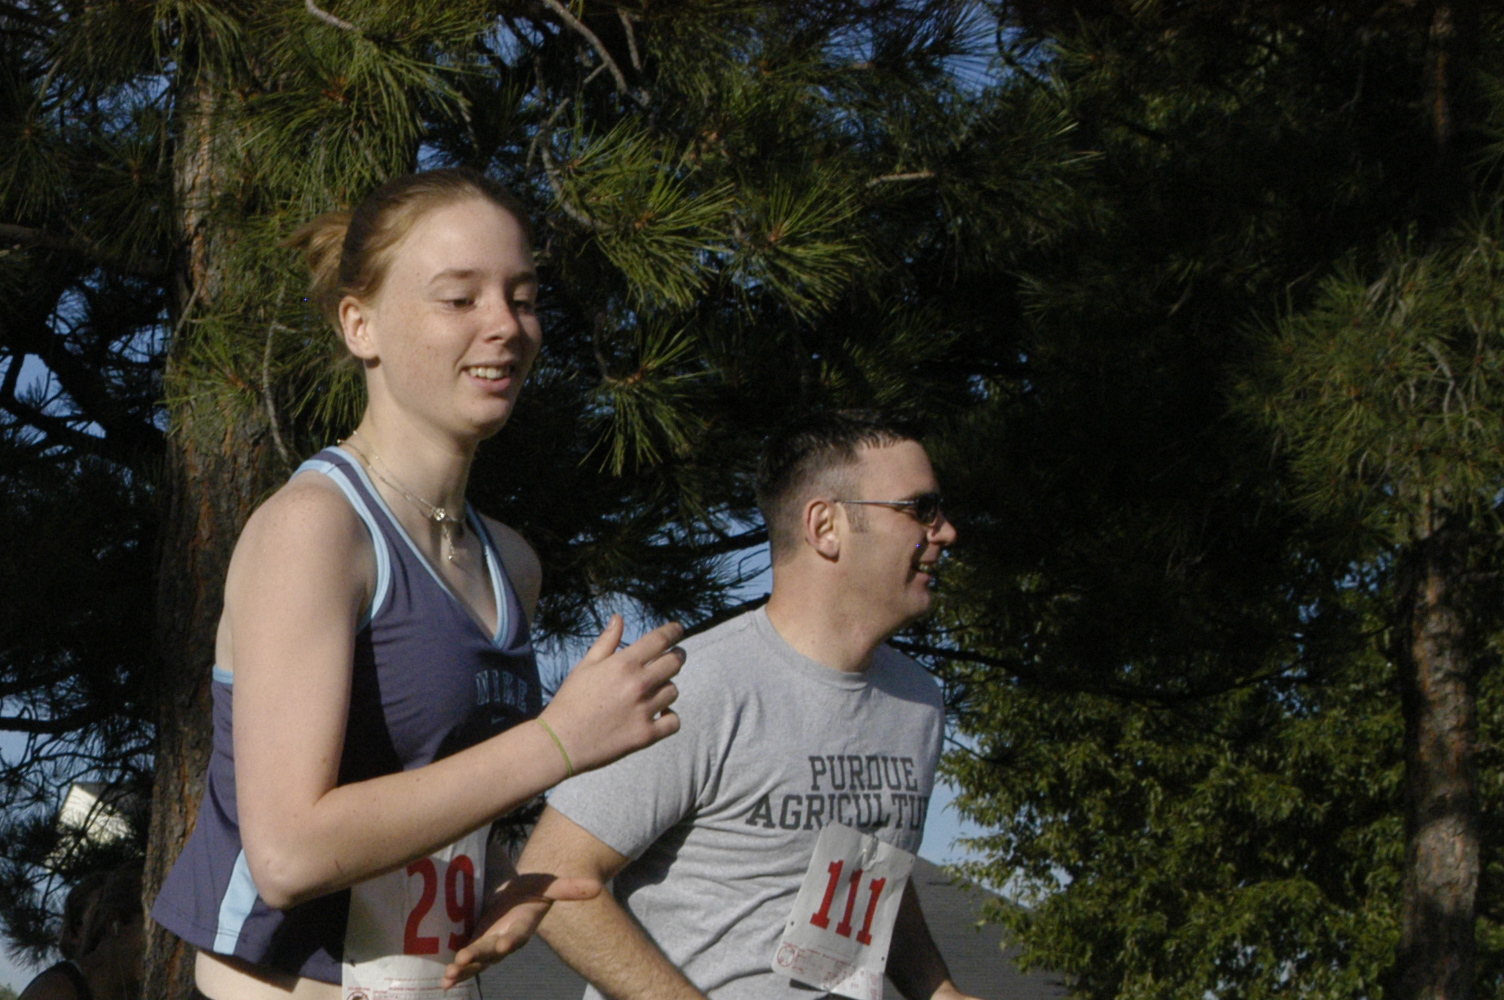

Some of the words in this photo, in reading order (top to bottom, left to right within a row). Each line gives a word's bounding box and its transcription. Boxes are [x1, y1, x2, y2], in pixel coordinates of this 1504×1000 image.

[808, 755, 918, 791] PURDUE
[746, 793, 930, 830] AGRICULTU
[403, 854, 475, 956] 29
[809, 859, 886, 946] 111
